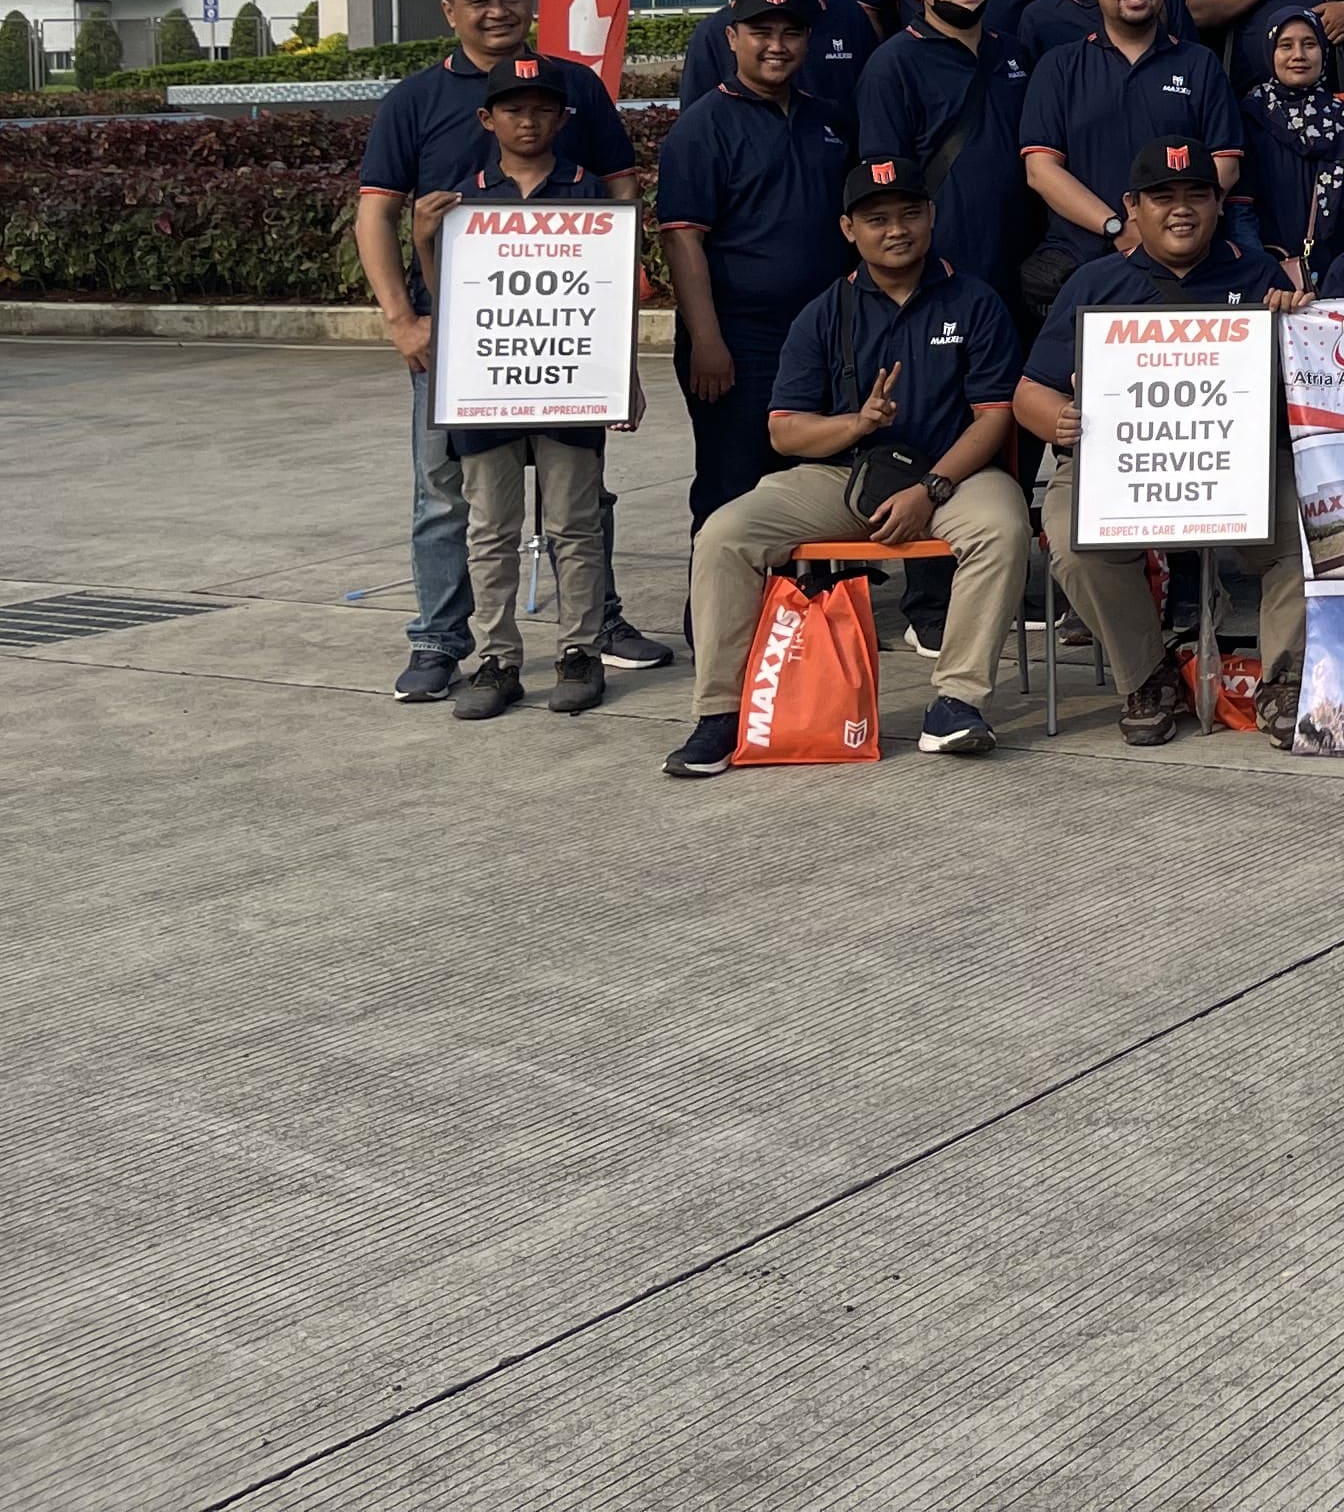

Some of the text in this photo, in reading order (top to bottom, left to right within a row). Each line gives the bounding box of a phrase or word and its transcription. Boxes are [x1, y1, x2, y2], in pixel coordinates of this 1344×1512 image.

[465, 211, 614, 235] MAXXIS
[498, 243, 583, 258] CULTURE
[487, 270, 590, 296] 100%
[476, 307, 596, 329] QUALITY
[1105, 318, 1250, 344] MAXXIS
[476, 337, 592, 357] SERVICE
[1137, 352, 1220, 368] CULTURE
[487, 365, 579, 385] TRUST
[1294, 371, 1333, 386] Atria
[1126, 379, 1228, 408] 100%
[457, 407, 498, 417] RESPECT
[511, 406, 535, 416] CARE
[542, 405, 608, 416] APPRECIATION
[1116, 420, 1234, 444] QUALITY
[1117, 451, 1231, 473] SERVICE
[1128, 481, 1218, 503] TRUST
[1100, 526, 1139, 537] RESPECT
[1152, 524, 1176, 536] CARE
[1182, 522, 1247, 535] APPRECIATION
[746, 605, 801, 748] MAXXIS
